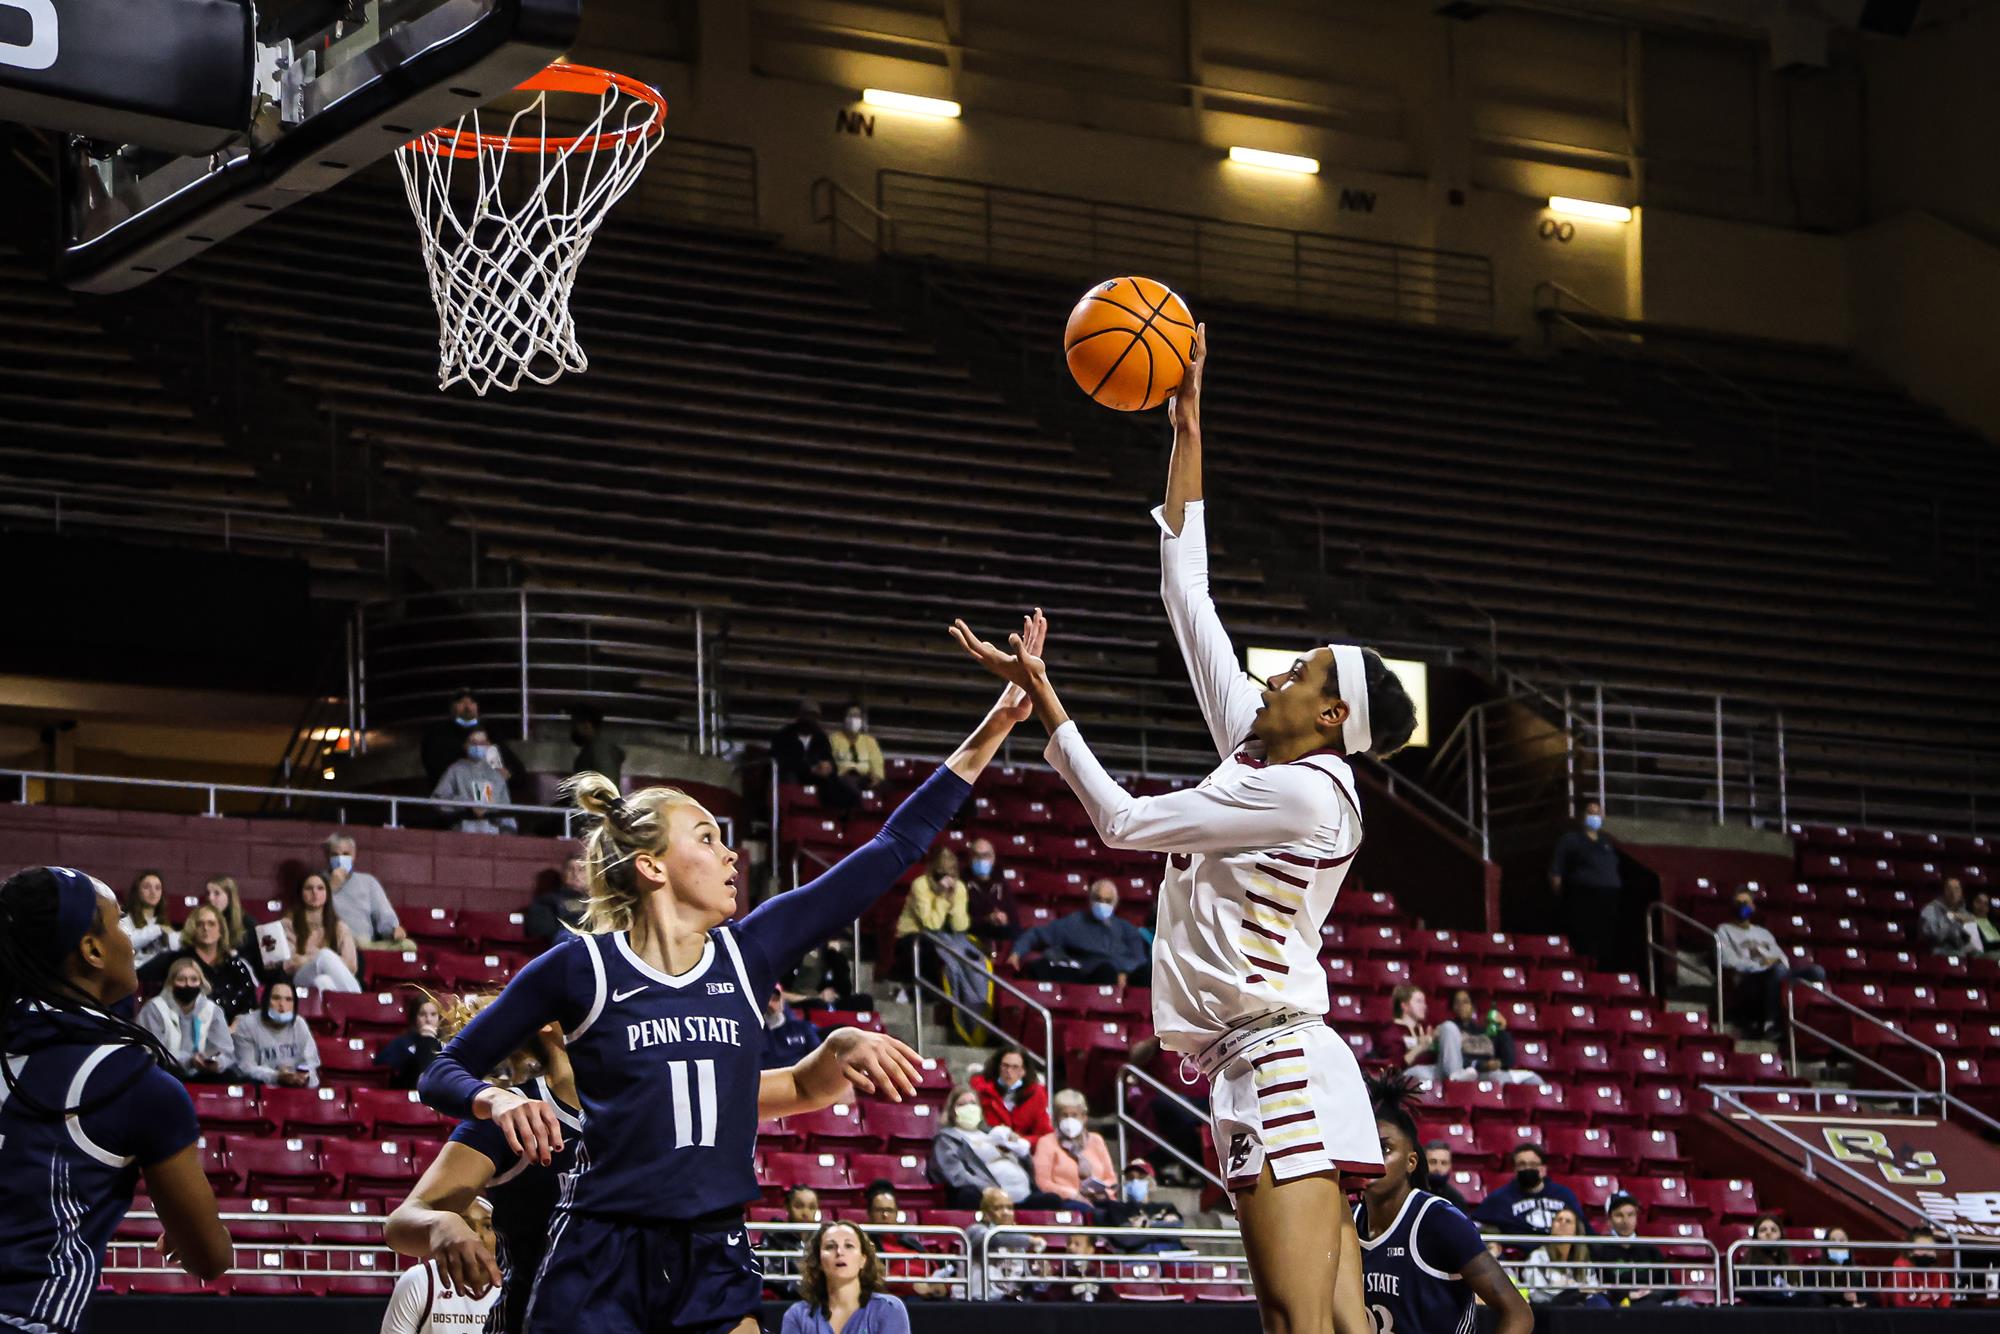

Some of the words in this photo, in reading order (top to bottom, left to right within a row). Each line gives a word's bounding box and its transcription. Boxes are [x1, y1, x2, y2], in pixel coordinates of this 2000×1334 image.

[626, 1016, 682, 1051] PENN
[684, 1015, 741, 1047] STATE
[667, 1058, 718, 1149] 11
[1367, 1272, 1400, 1297] STATE
[432, 1313, 474, 1325] BOSTON
